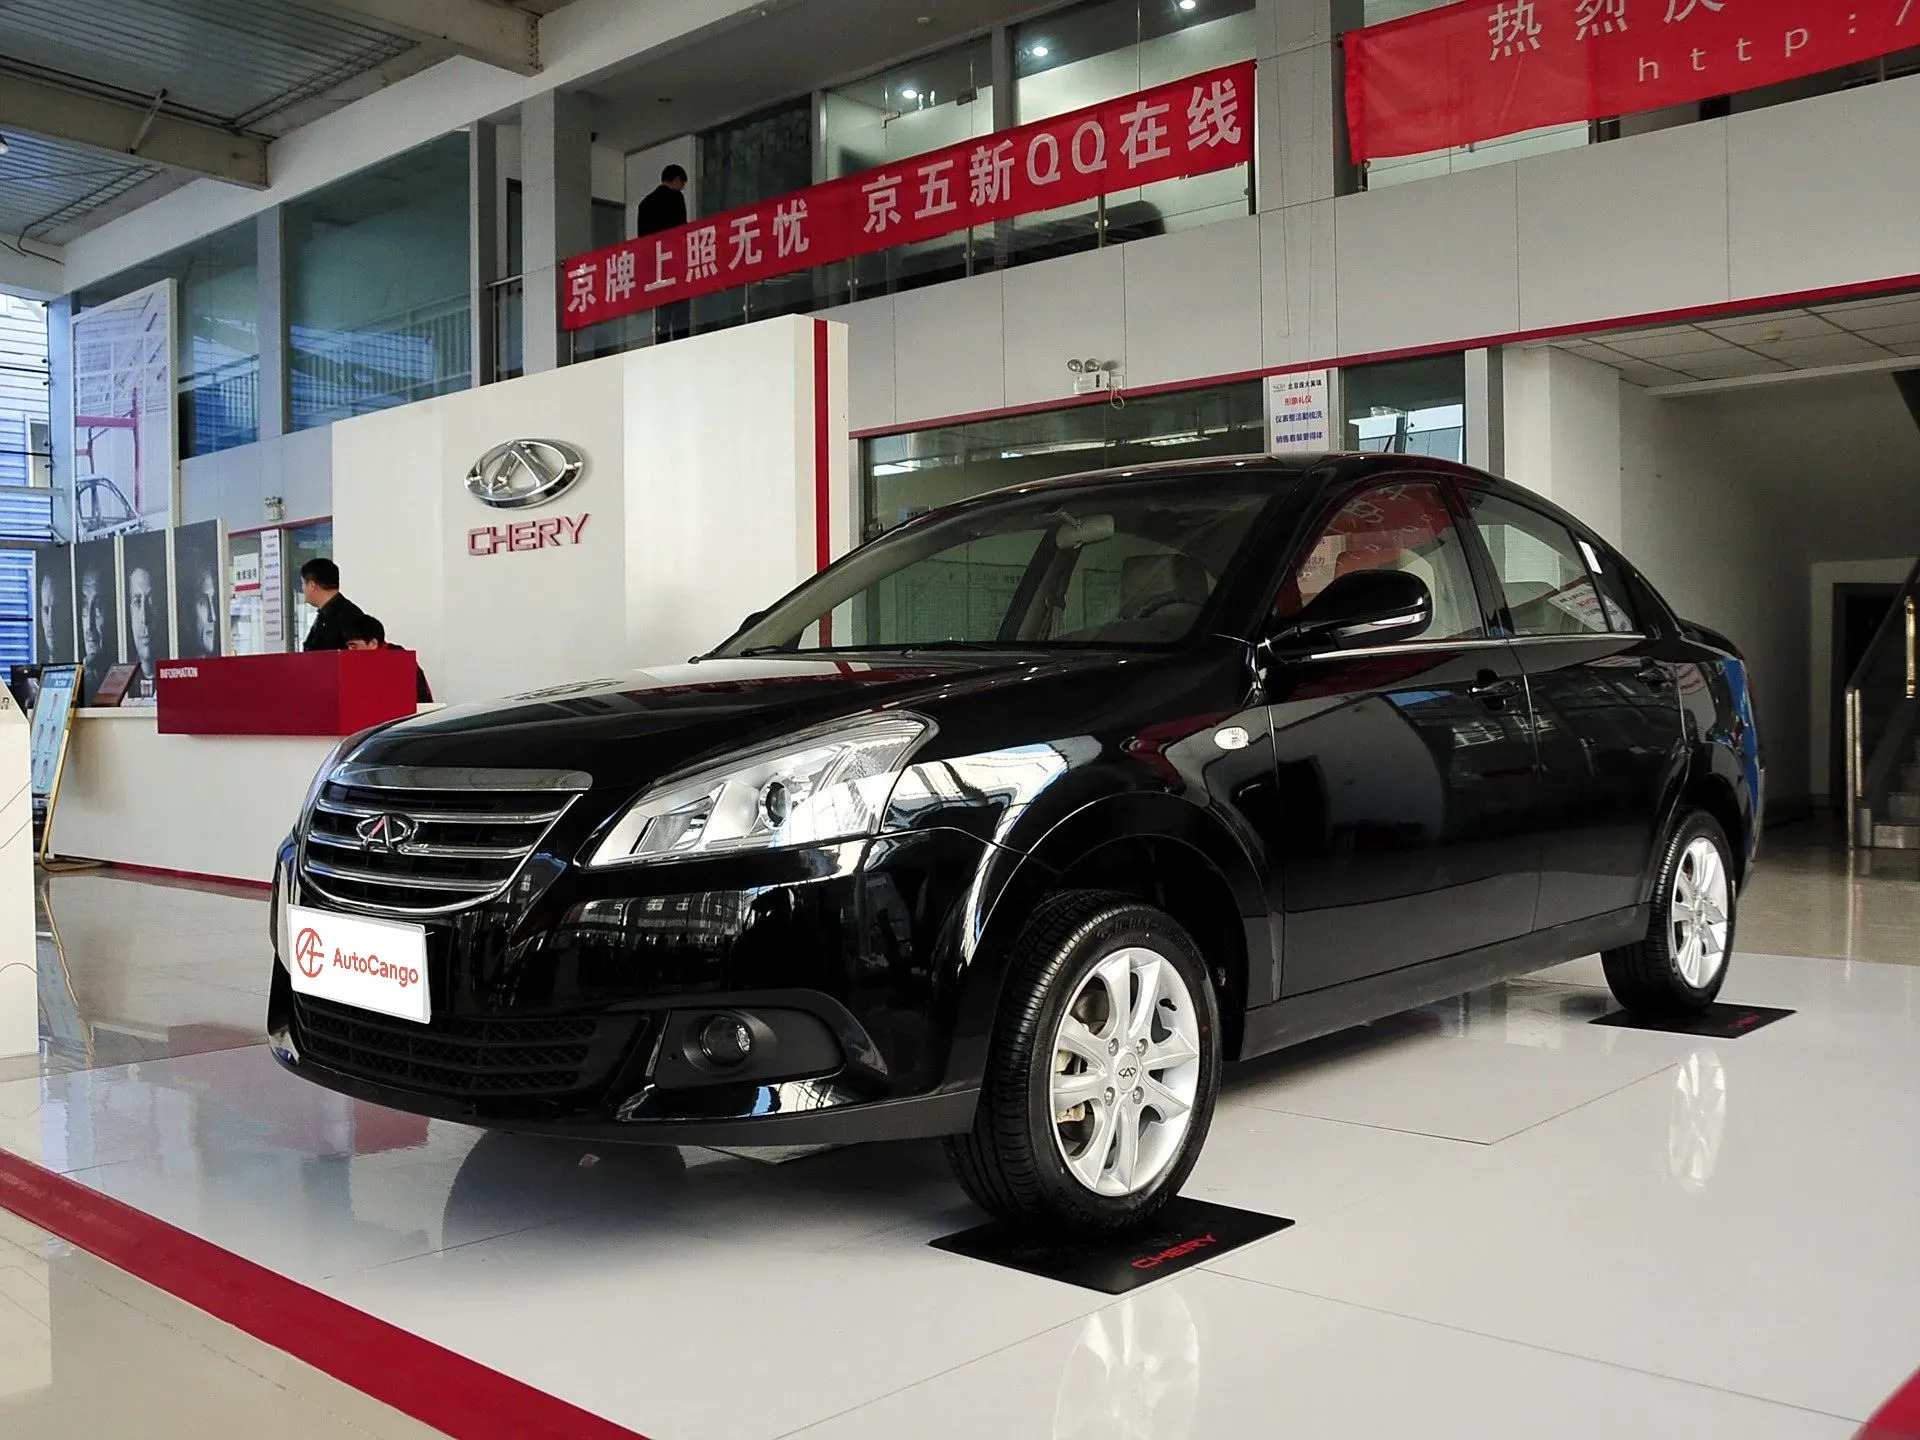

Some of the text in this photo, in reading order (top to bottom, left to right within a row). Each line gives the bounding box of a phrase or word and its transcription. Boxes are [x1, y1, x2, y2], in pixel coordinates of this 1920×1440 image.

[567, 78, 1242, 313] 京牌上照无忧 京五新QQ在线
[1284, 395, 1312, 406] 形象礼仪
[467, 513, 591, 556] CHERY
[160, 667, 198, 679] INFORMATION
